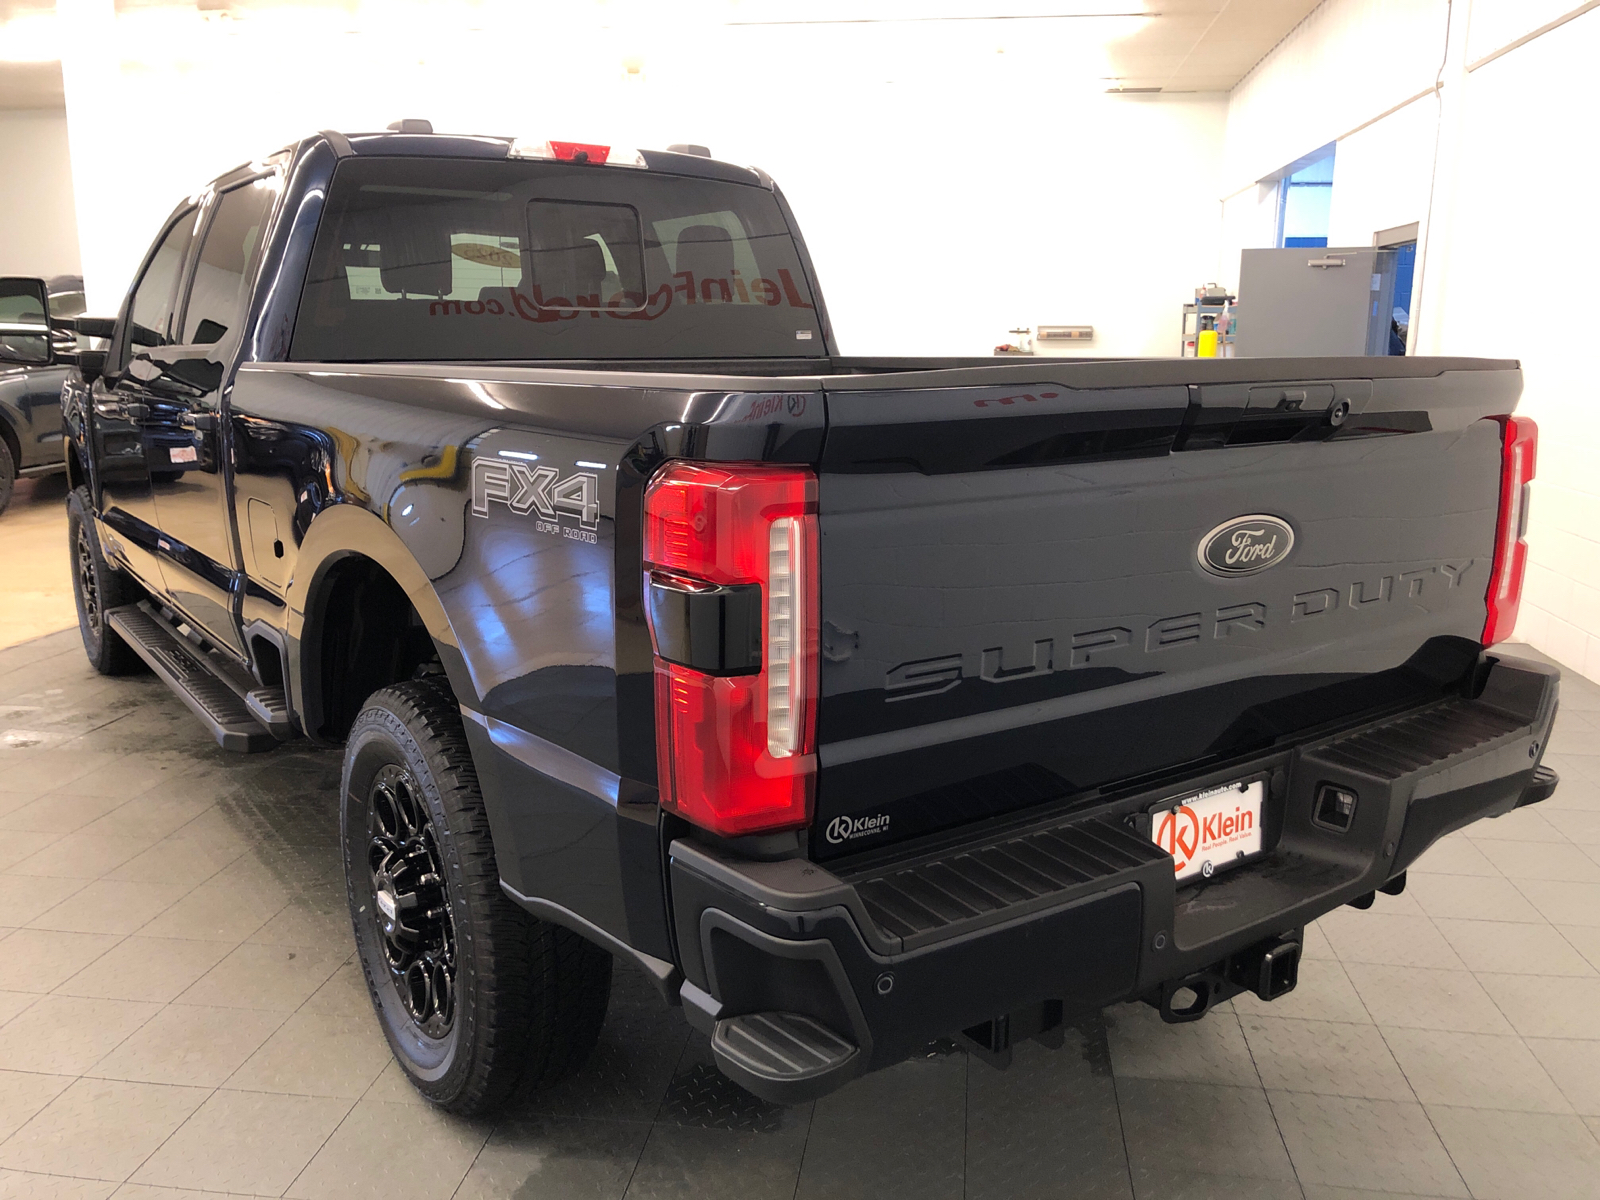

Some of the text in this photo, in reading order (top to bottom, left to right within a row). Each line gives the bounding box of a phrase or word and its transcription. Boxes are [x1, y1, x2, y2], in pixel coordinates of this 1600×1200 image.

[472, 456, 600, 530] FX4
[536, 520, 598, 544] OFF ROAD
[1225, 529, 1277, 564] Ford
[885, 558, 1475, 702] SUPER DUTY
[853, 813, 890, 832] Klein
[1202, 806, 1253, 844] Klein
